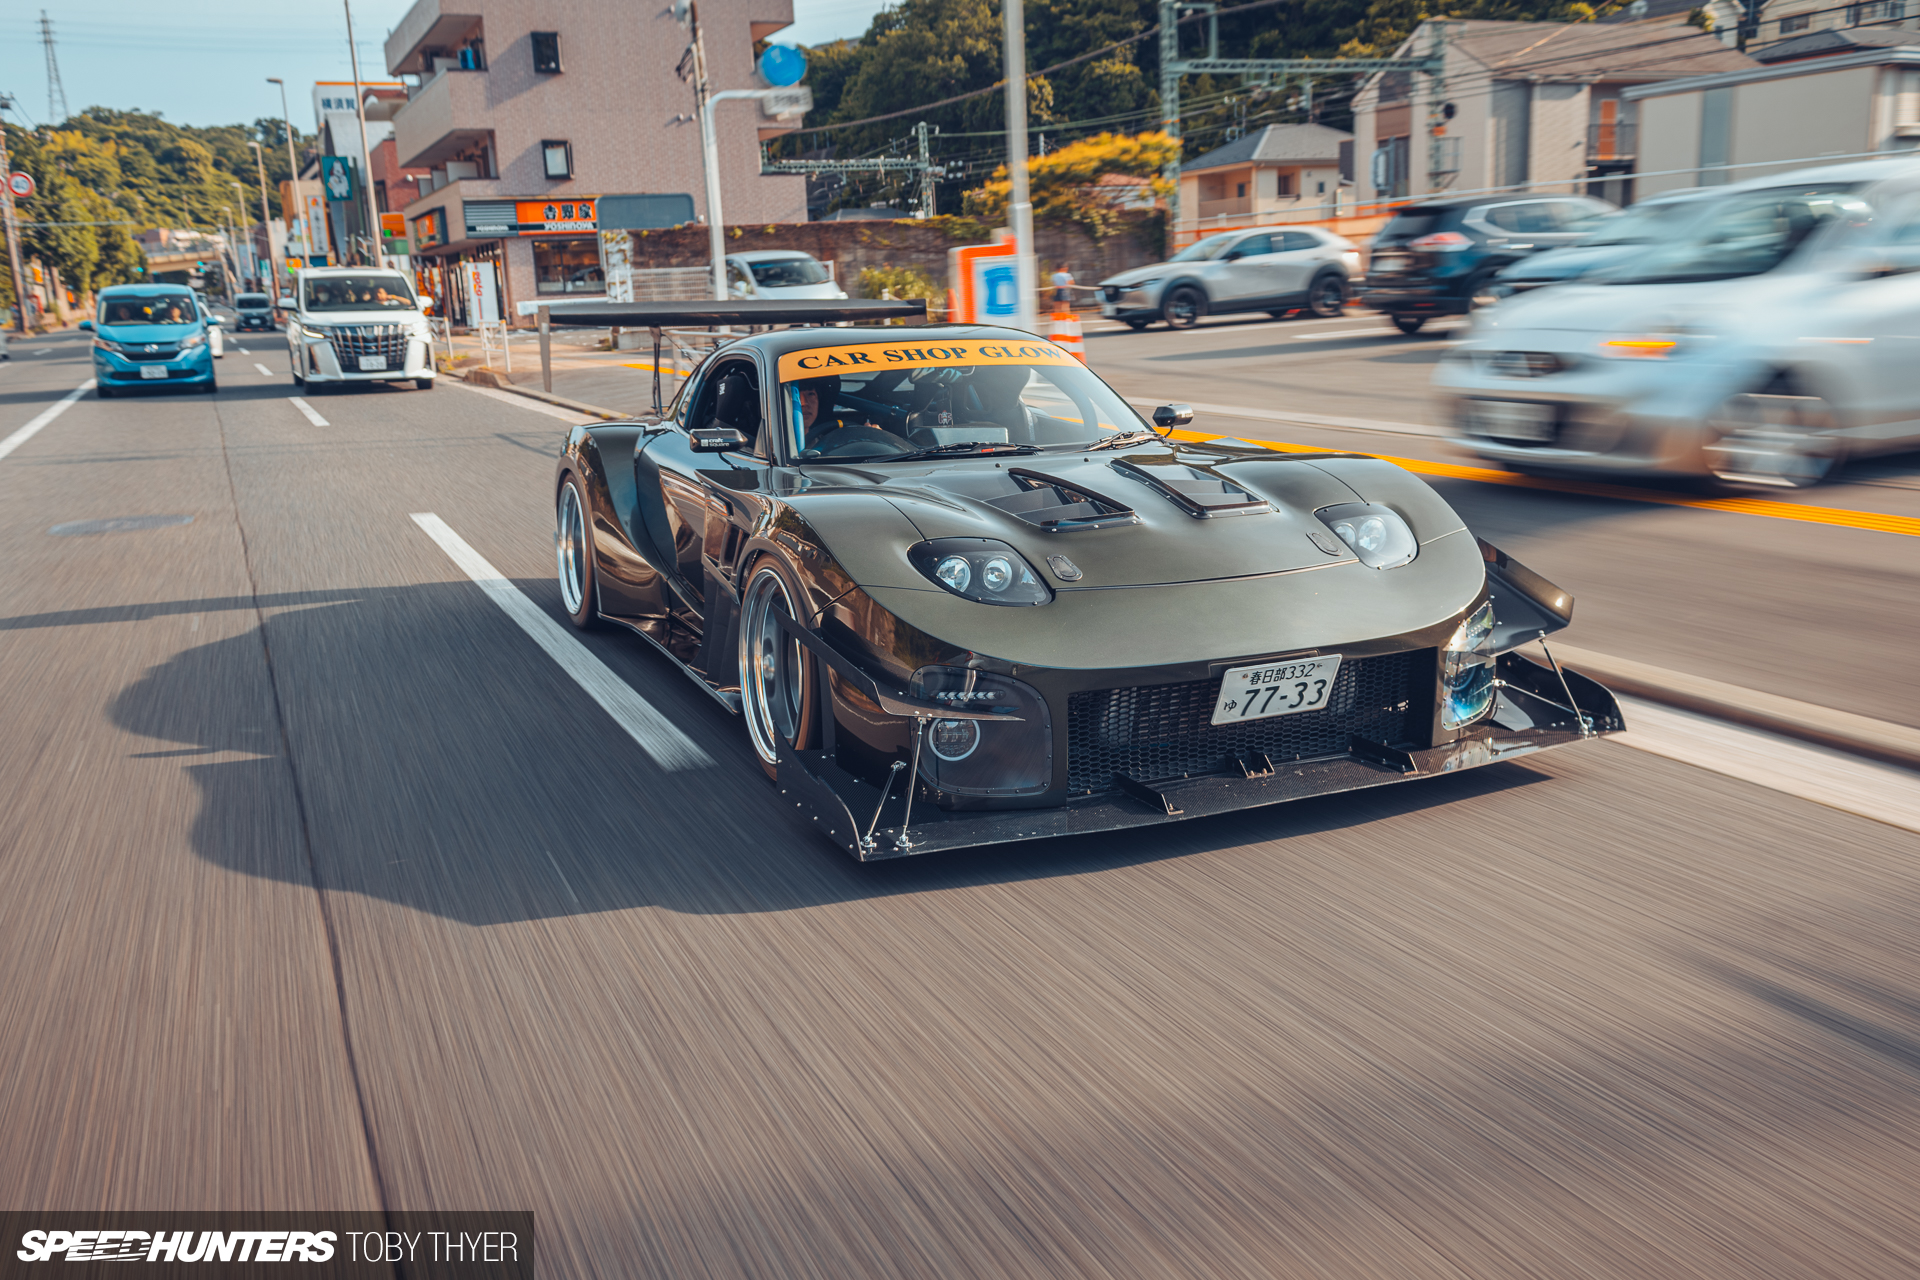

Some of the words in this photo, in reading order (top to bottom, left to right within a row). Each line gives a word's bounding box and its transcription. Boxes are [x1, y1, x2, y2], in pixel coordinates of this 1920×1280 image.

[544, 221, 594, 231] YOSHINOYA
[797, 351, 876, 370] CAR
[882, 346, 968, 363] SHOP
[978, 345, 1063, 360] GLOW
[1223, 699, 1238, 712] ゆ
[1240, 679, 1328, 717] 77-33
